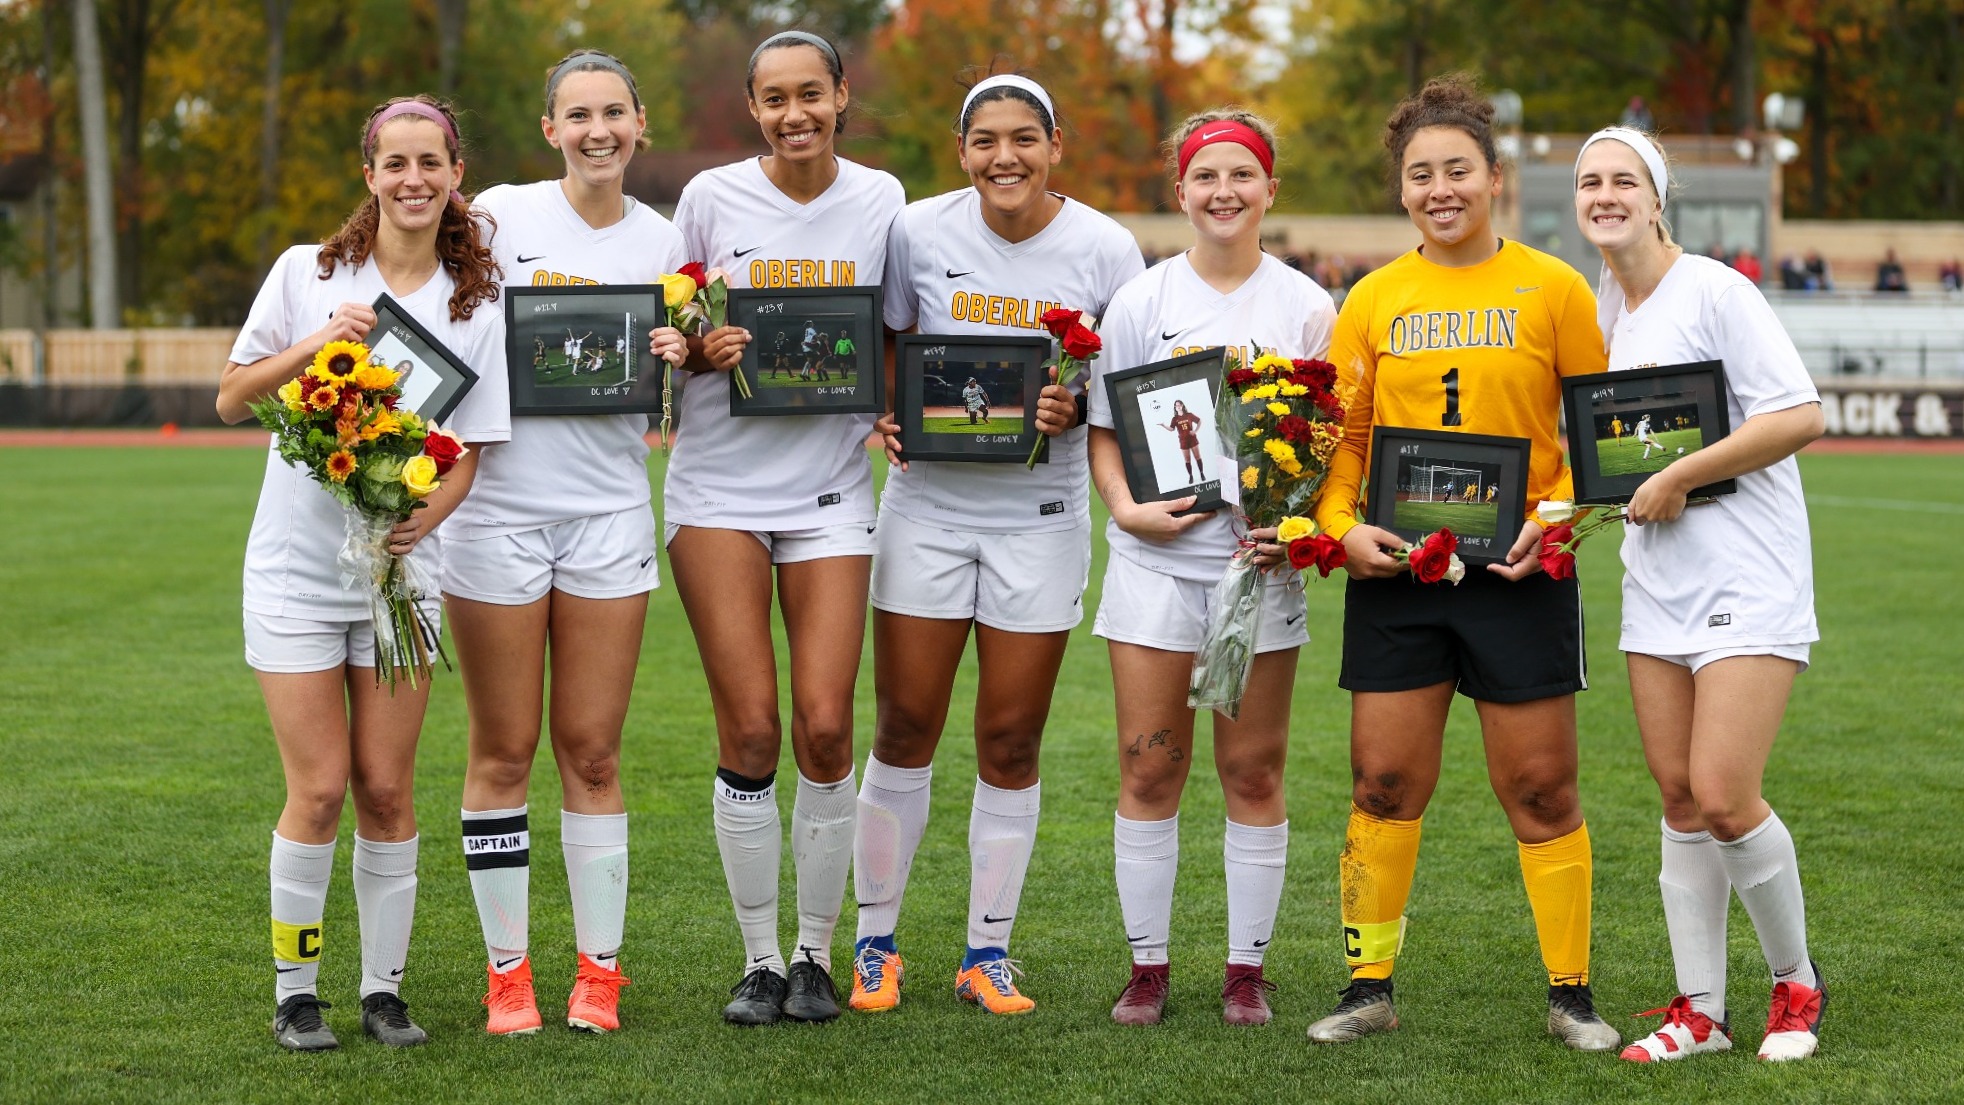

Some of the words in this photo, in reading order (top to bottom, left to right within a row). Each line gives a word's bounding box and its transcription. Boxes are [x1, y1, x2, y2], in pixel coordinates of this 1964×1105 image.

[750, 259, 856, 289] OBERLIN
[1390, 308, 1518, 357] OBERLIN
[604, 387, 619, 395] LOVE
[831, 386, 847, 395] LOVE
[1441, 367, 1462, 427] 1
[1820, 393, 1902, 435] ACK
[976, 434, 989, 443] OC
[992, 434, 1012, 443] LOVE
[1463, 537, 1480, 546] LOVE
[468, 835, 521, 851] CAPTAIN
[298, 928, 320, 958] C
[1344, 926, 1361, 957] C
